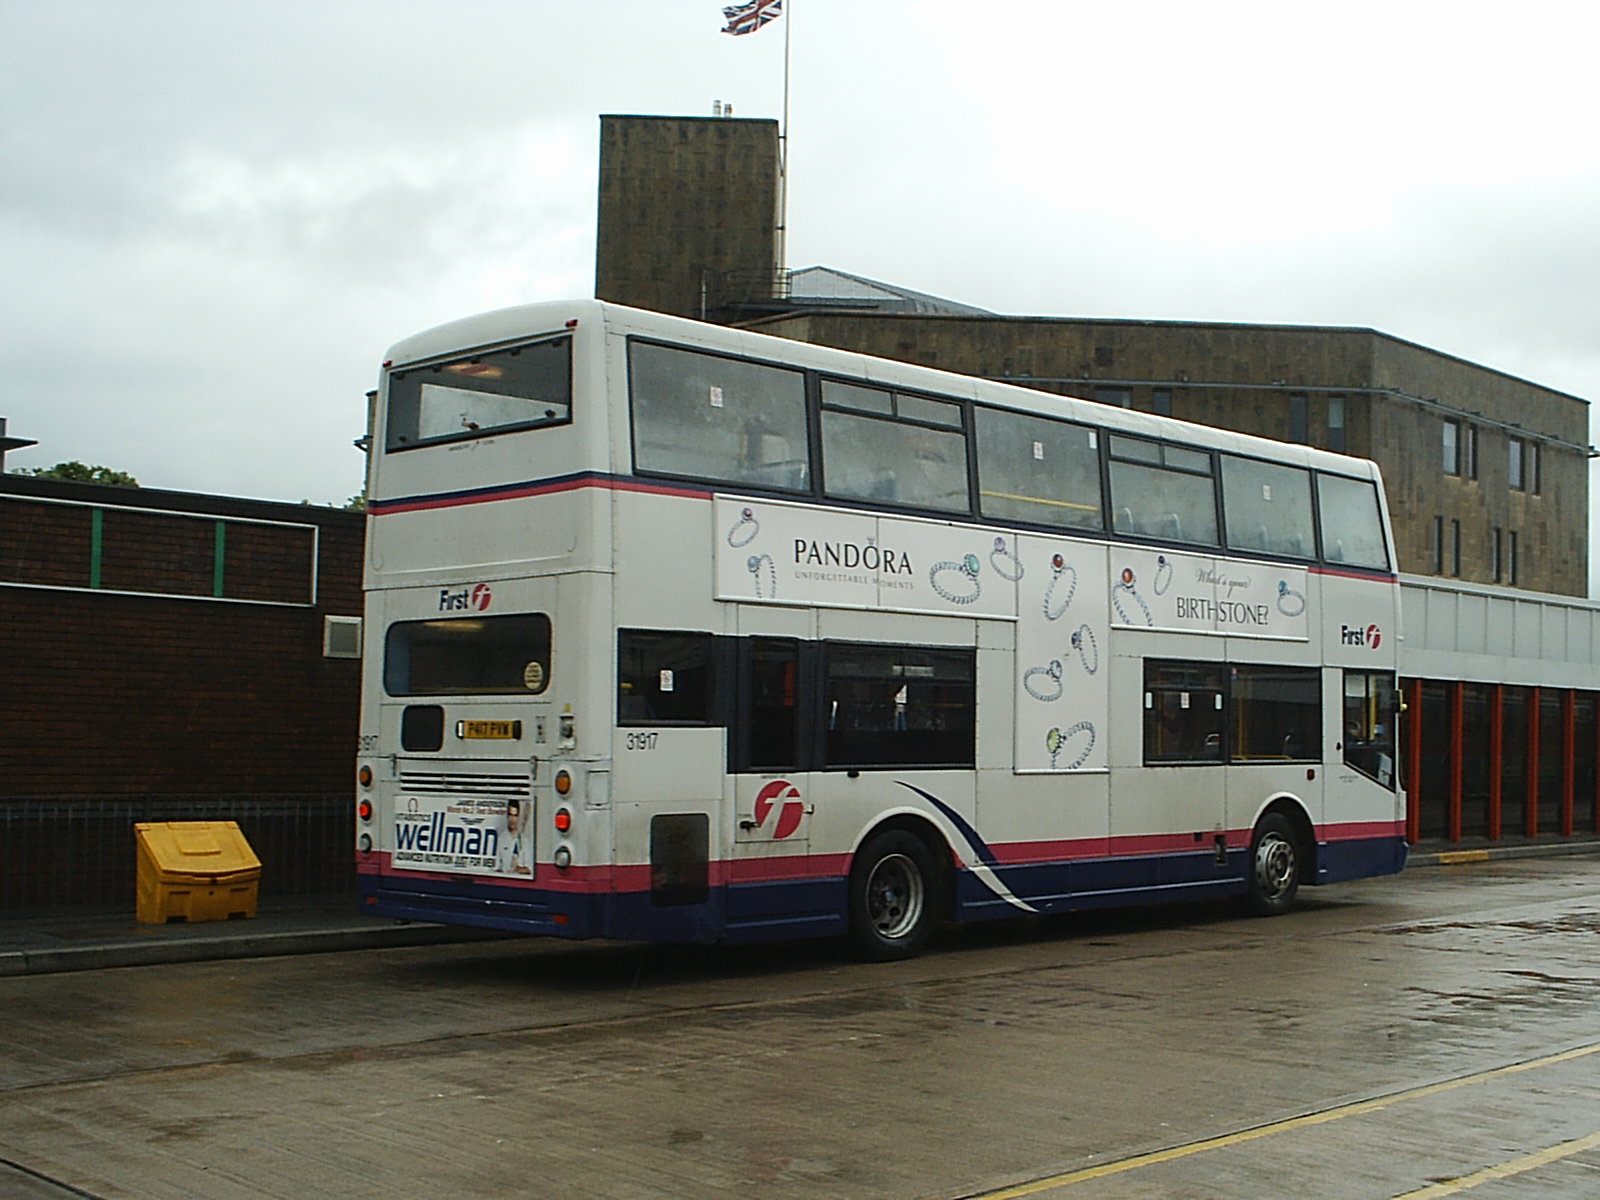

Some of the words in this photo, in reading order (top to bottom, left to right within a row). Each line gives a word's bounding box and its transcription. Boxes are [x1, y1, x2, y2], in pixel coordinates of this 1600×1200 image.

[794, 538, 913, 575] PANDORA
[794, 571, 868, 584] UNFORGETTABLE
[872, 577, 914, 590] MOMENTS
[438, 589, 469, 611] First
[1176, 597, 1269, 626] BIRTHSTONE?
[1341, 625, 1364, 646] First
[627, 732, 659, 750] 31917
[395, 811, 498, 857] wellman
